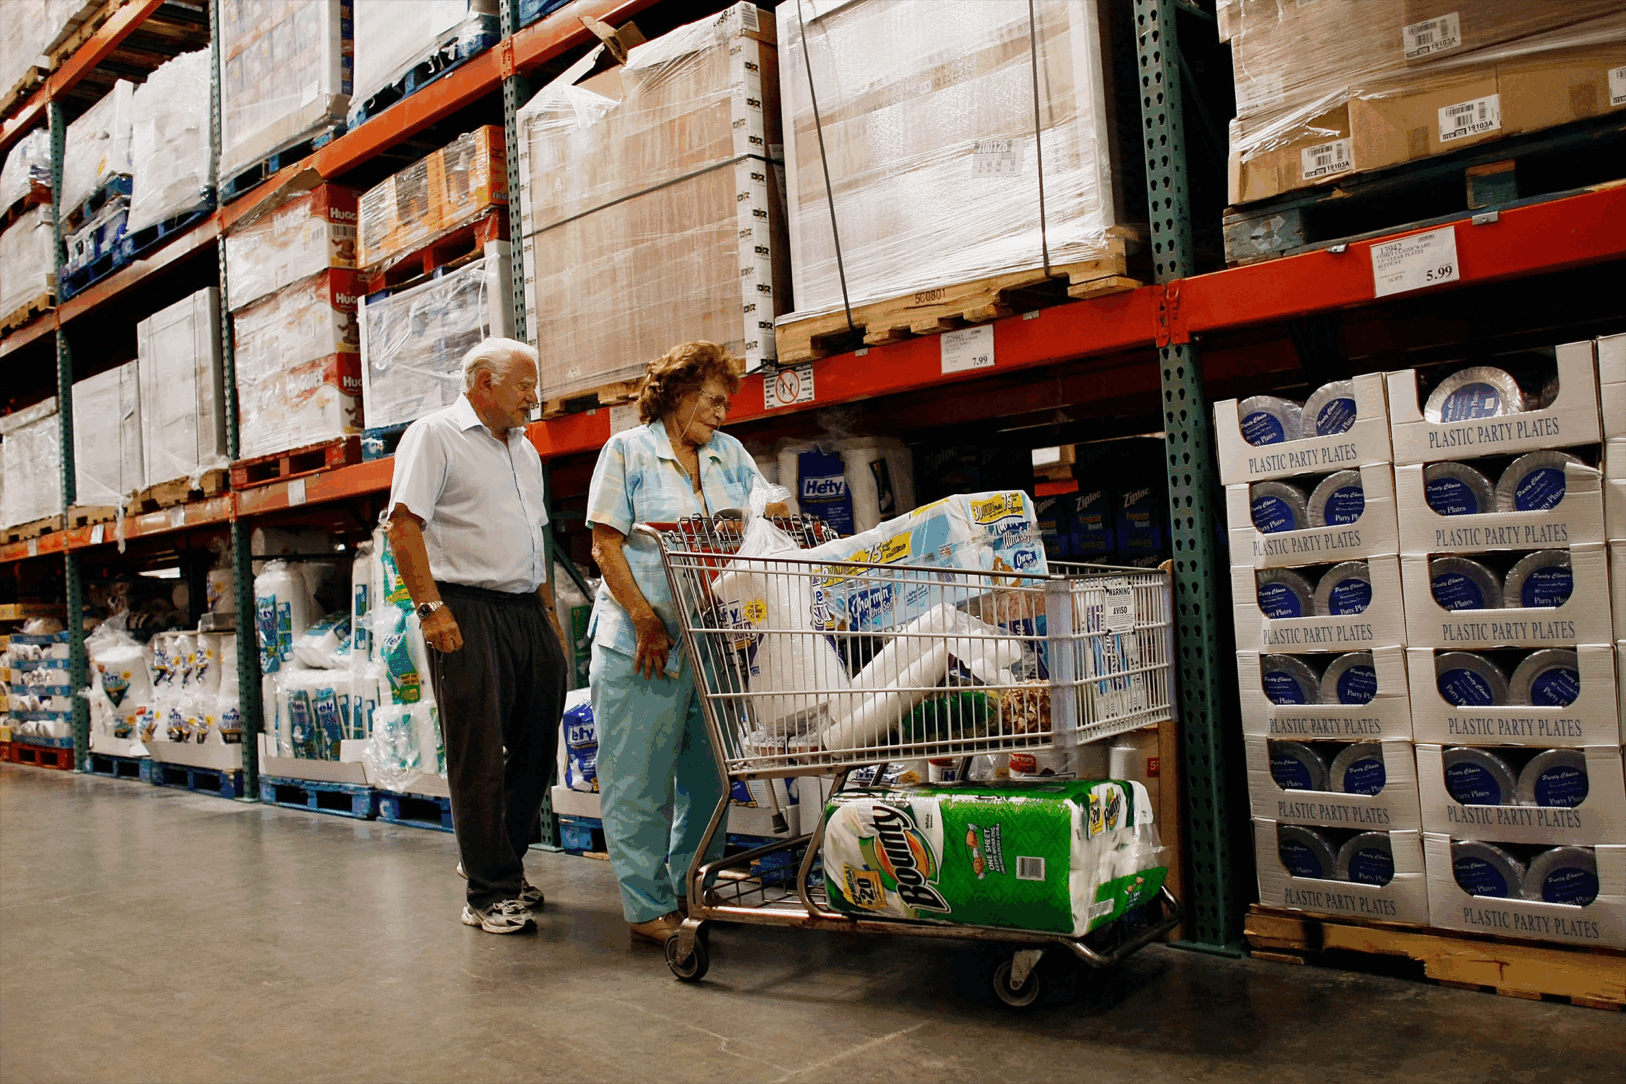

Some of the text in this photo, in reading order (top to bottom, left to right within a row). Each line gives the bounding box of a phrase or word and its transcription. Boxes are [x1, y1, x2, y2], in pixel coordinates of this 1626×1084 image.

[1467, 120, 1493, 132] 19103A
[1426, 265, 1453, 282] 5.99
[972, 355, 988, 366] 7.99
[1429, 417, 1560, 449] PLASTIC PARTY PLATES
[1249, 444, 1357, 474] PLASTIC PARTY PLATES
[806, 480, 842, 495] Hefty
[1075, 491, 1102, 512] Ziploc
[1123, 488, 1150, 509] Ziploc
[1253, 530, 1361, 556] PLASTIC PARTY PLATES
[1436, 524, 1568, 547] PLASTIC PARTY PLATES
[865, 542, 882, 563] 75
[1109, 587, 1130, 597] WARNING
[1113, 605, 1128, 615] AVISO
[1263, 624, 1373, 645] PLASTIC PARTY PLATES
[1442, 621, 1575, 641] PLASTIC PARTY PLATES
[1270, 718, 1381, 734] PLASTIC PARTY PLATES
[1448, 718, 1582, 737] PLASTIC PARTY PLATES
[1278, 802, 1389, 824] PLASTIC PARTY PLATES
[1447, 805, 1581, 829] PLASTIC PARTY PLATES
[872, 804, 951, 914] Bounty
[984, 828, 995, 871] ONE SHEET
[1285, 888, 1396, 916] PLASTIC PARTY PLATES
[1463, 907, 1599, 939] PLASTIC PARTY PLATES
